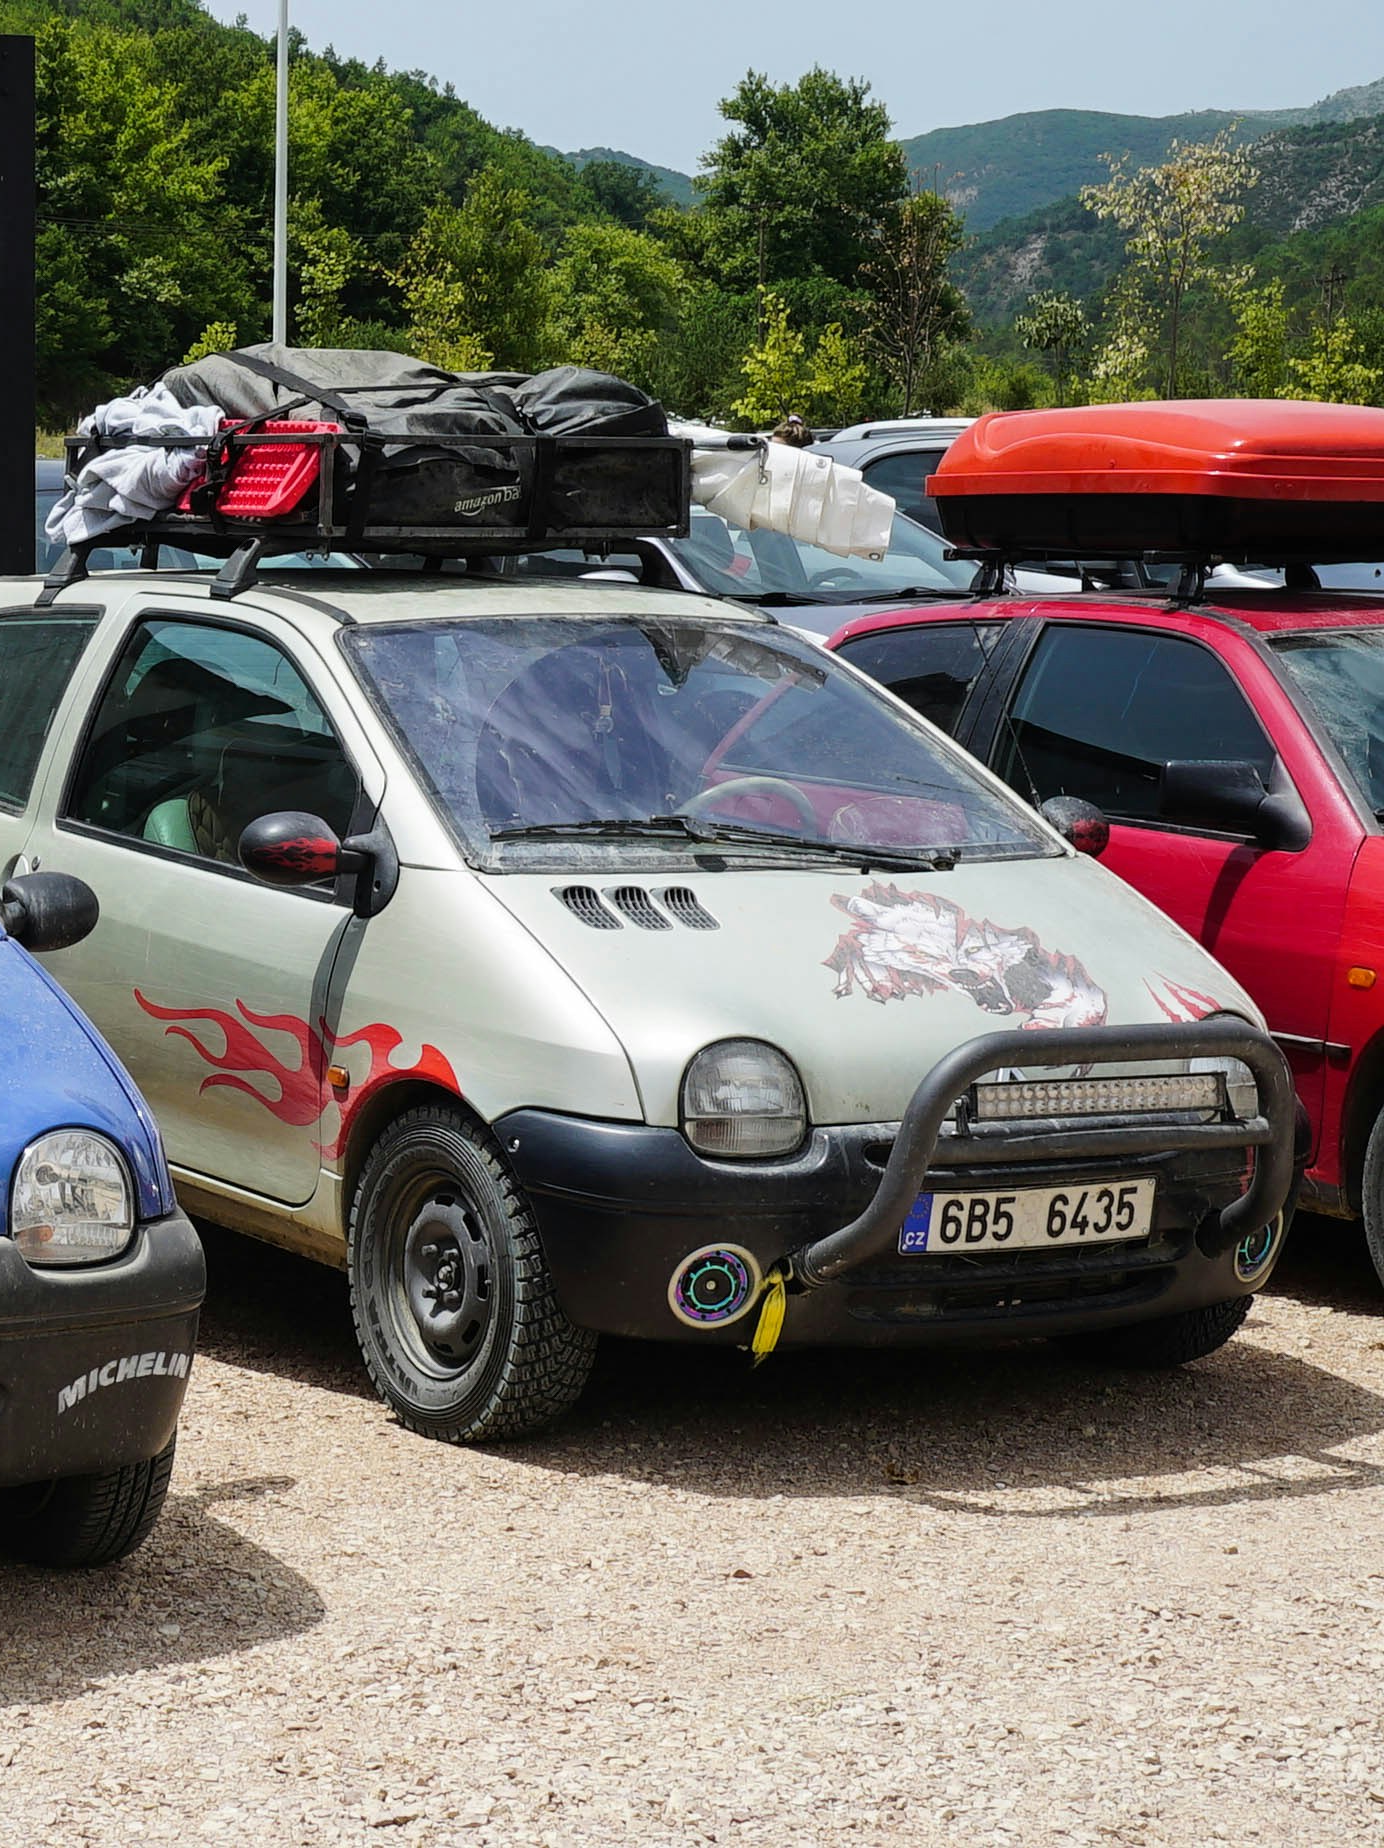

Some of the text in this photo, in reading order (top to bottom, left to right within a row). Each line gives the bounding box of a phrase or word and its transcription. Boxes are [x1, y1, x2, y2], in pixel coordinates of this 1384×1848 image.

[454, 486, 521, 513] amazon ba
[939, 1187, 1138, 1244] 6B5 6435
[904, 1231, 925, 1247] CZ
[57, 1351, 191, 1416] MICHELIN
